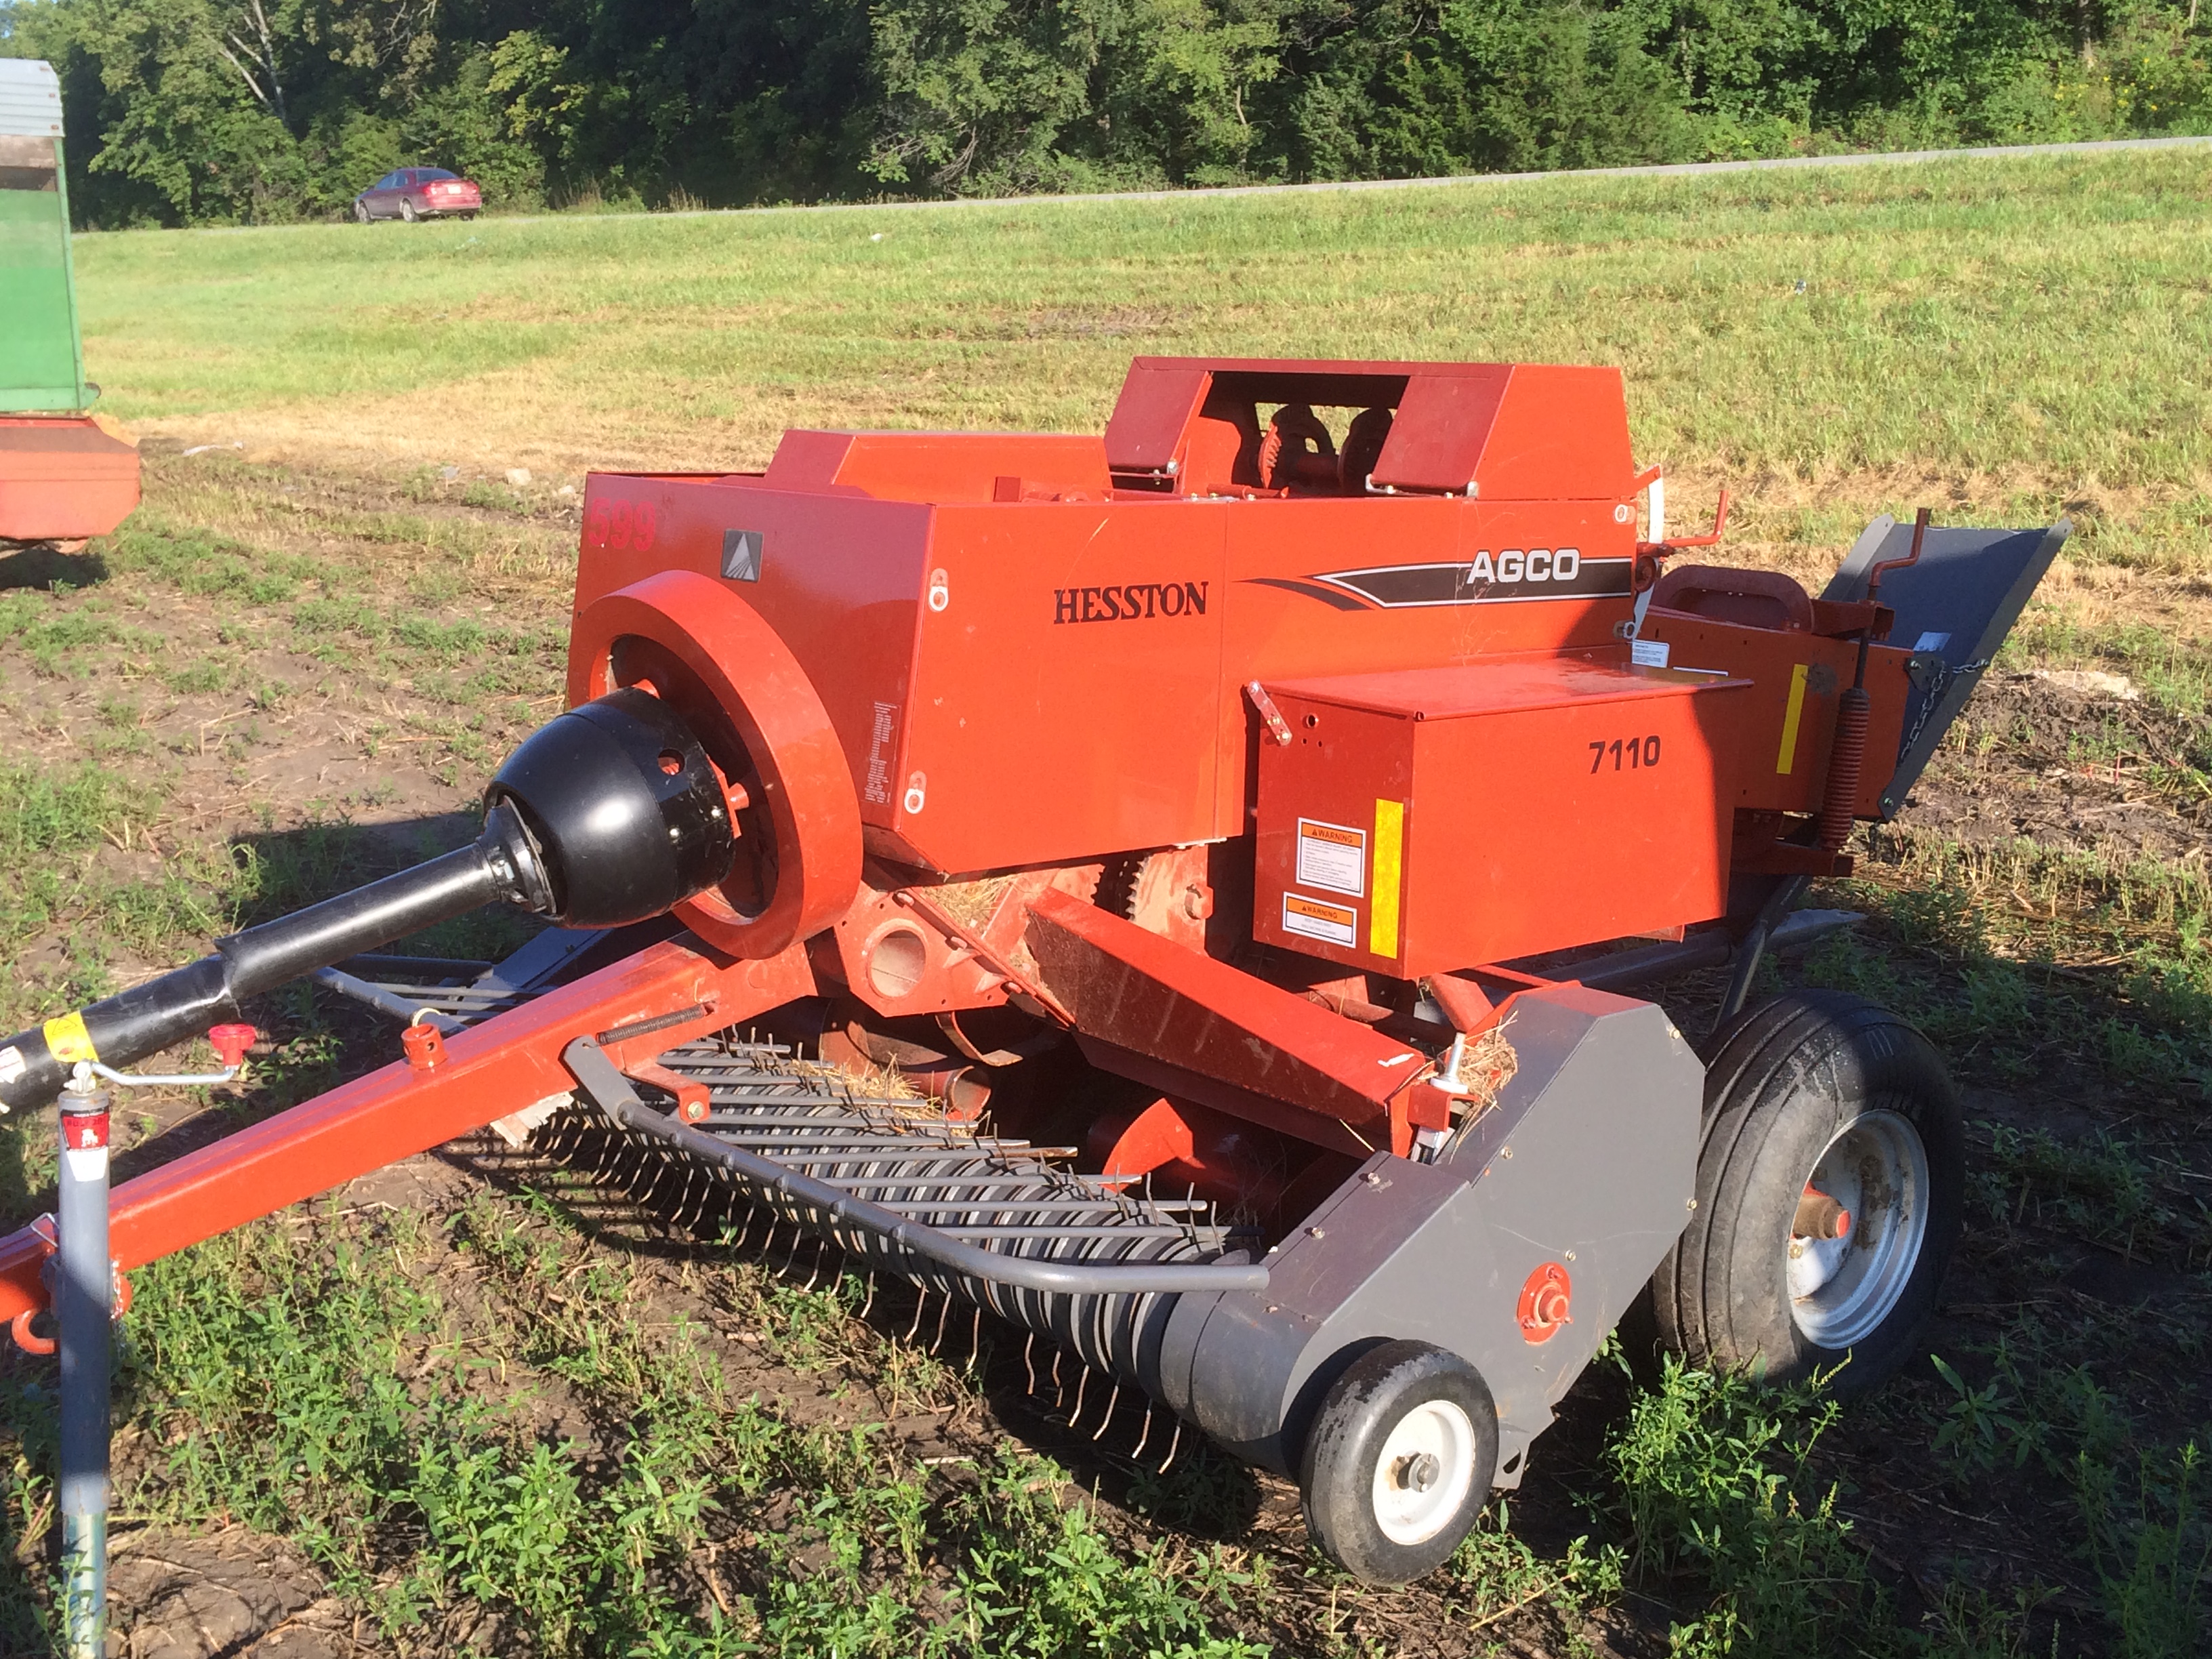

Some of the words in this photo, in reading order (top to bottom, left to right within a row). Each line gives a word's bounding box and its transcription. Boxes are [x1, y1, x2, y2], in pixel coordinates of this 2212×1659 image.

[588, 497, 655, 551] 599
[1467, 548, 1580, 584] AGCO
[1054, 581, 1208, 624] HESSTON
[1589, 735, 1660, 775] 7110
[1318, 829, 1353, 843] WARNING
